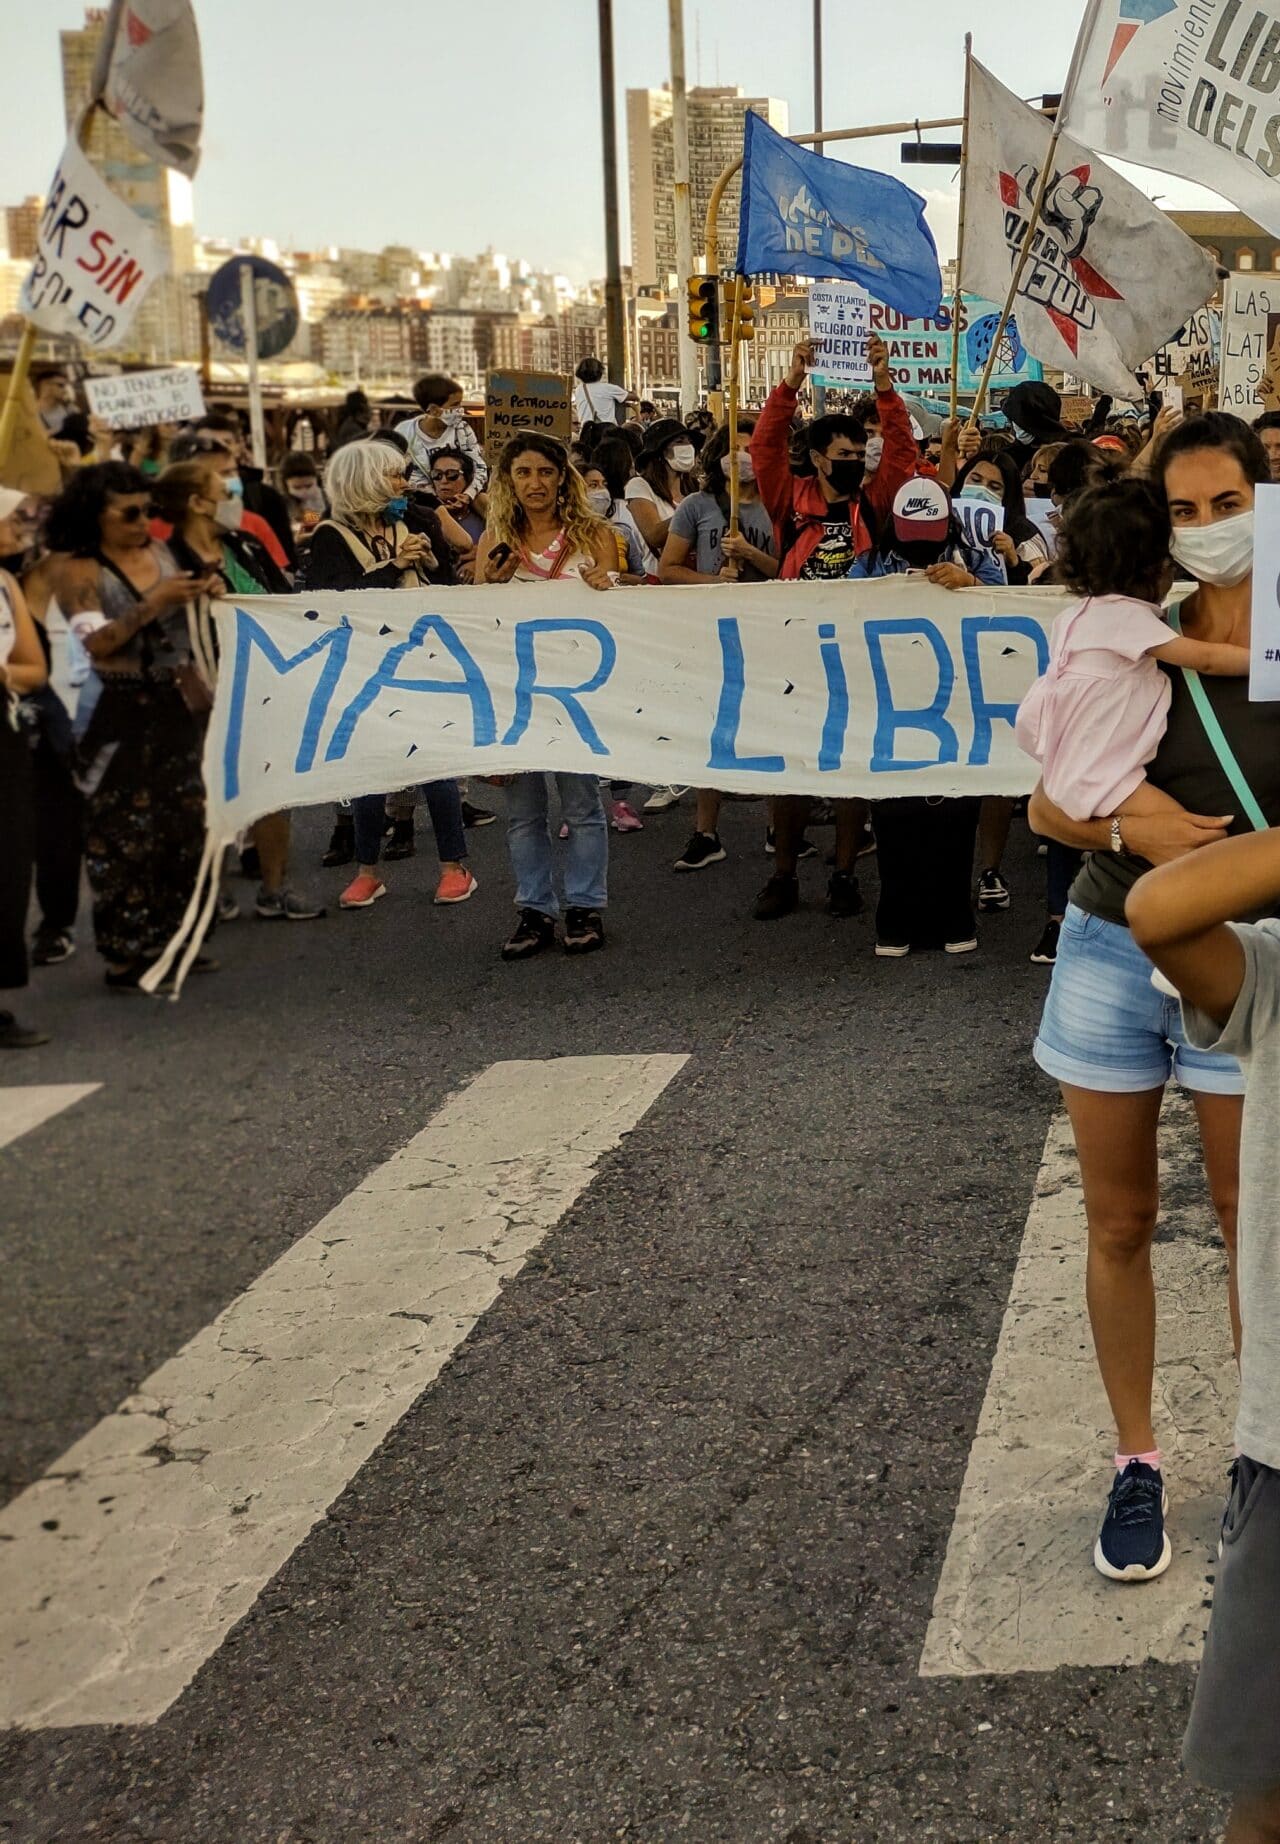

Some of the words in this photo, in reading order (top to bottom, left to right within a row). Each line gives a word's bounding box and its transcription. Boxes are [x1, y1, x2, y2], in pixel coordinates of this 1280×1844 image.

[812, 293, 833, 302] COSTA
[834, 295, 867, 307] ATLANTICA
[1234, 290, 1271, 316] LAS
[814, 322, 853, 336] PELIGRO
[856, 327, 868, 337] DE
[887, 341, 937, 358] ATEN
[1227, 332, 1264, 358] LAT
[821, 359, 830, 368] AL
[1223, 384, 1264, 406] ABiE
[533, 415, 554, 427] NO
[906, 498, 932, 508] NIKE
[926, 508, 939, 516] SB
[952, 506, 996, 548] NO
[710, 526, 771, 555] BNX
[223, 607, 610, 801] MAR
[706, 616, 1050, 773] LiBR
